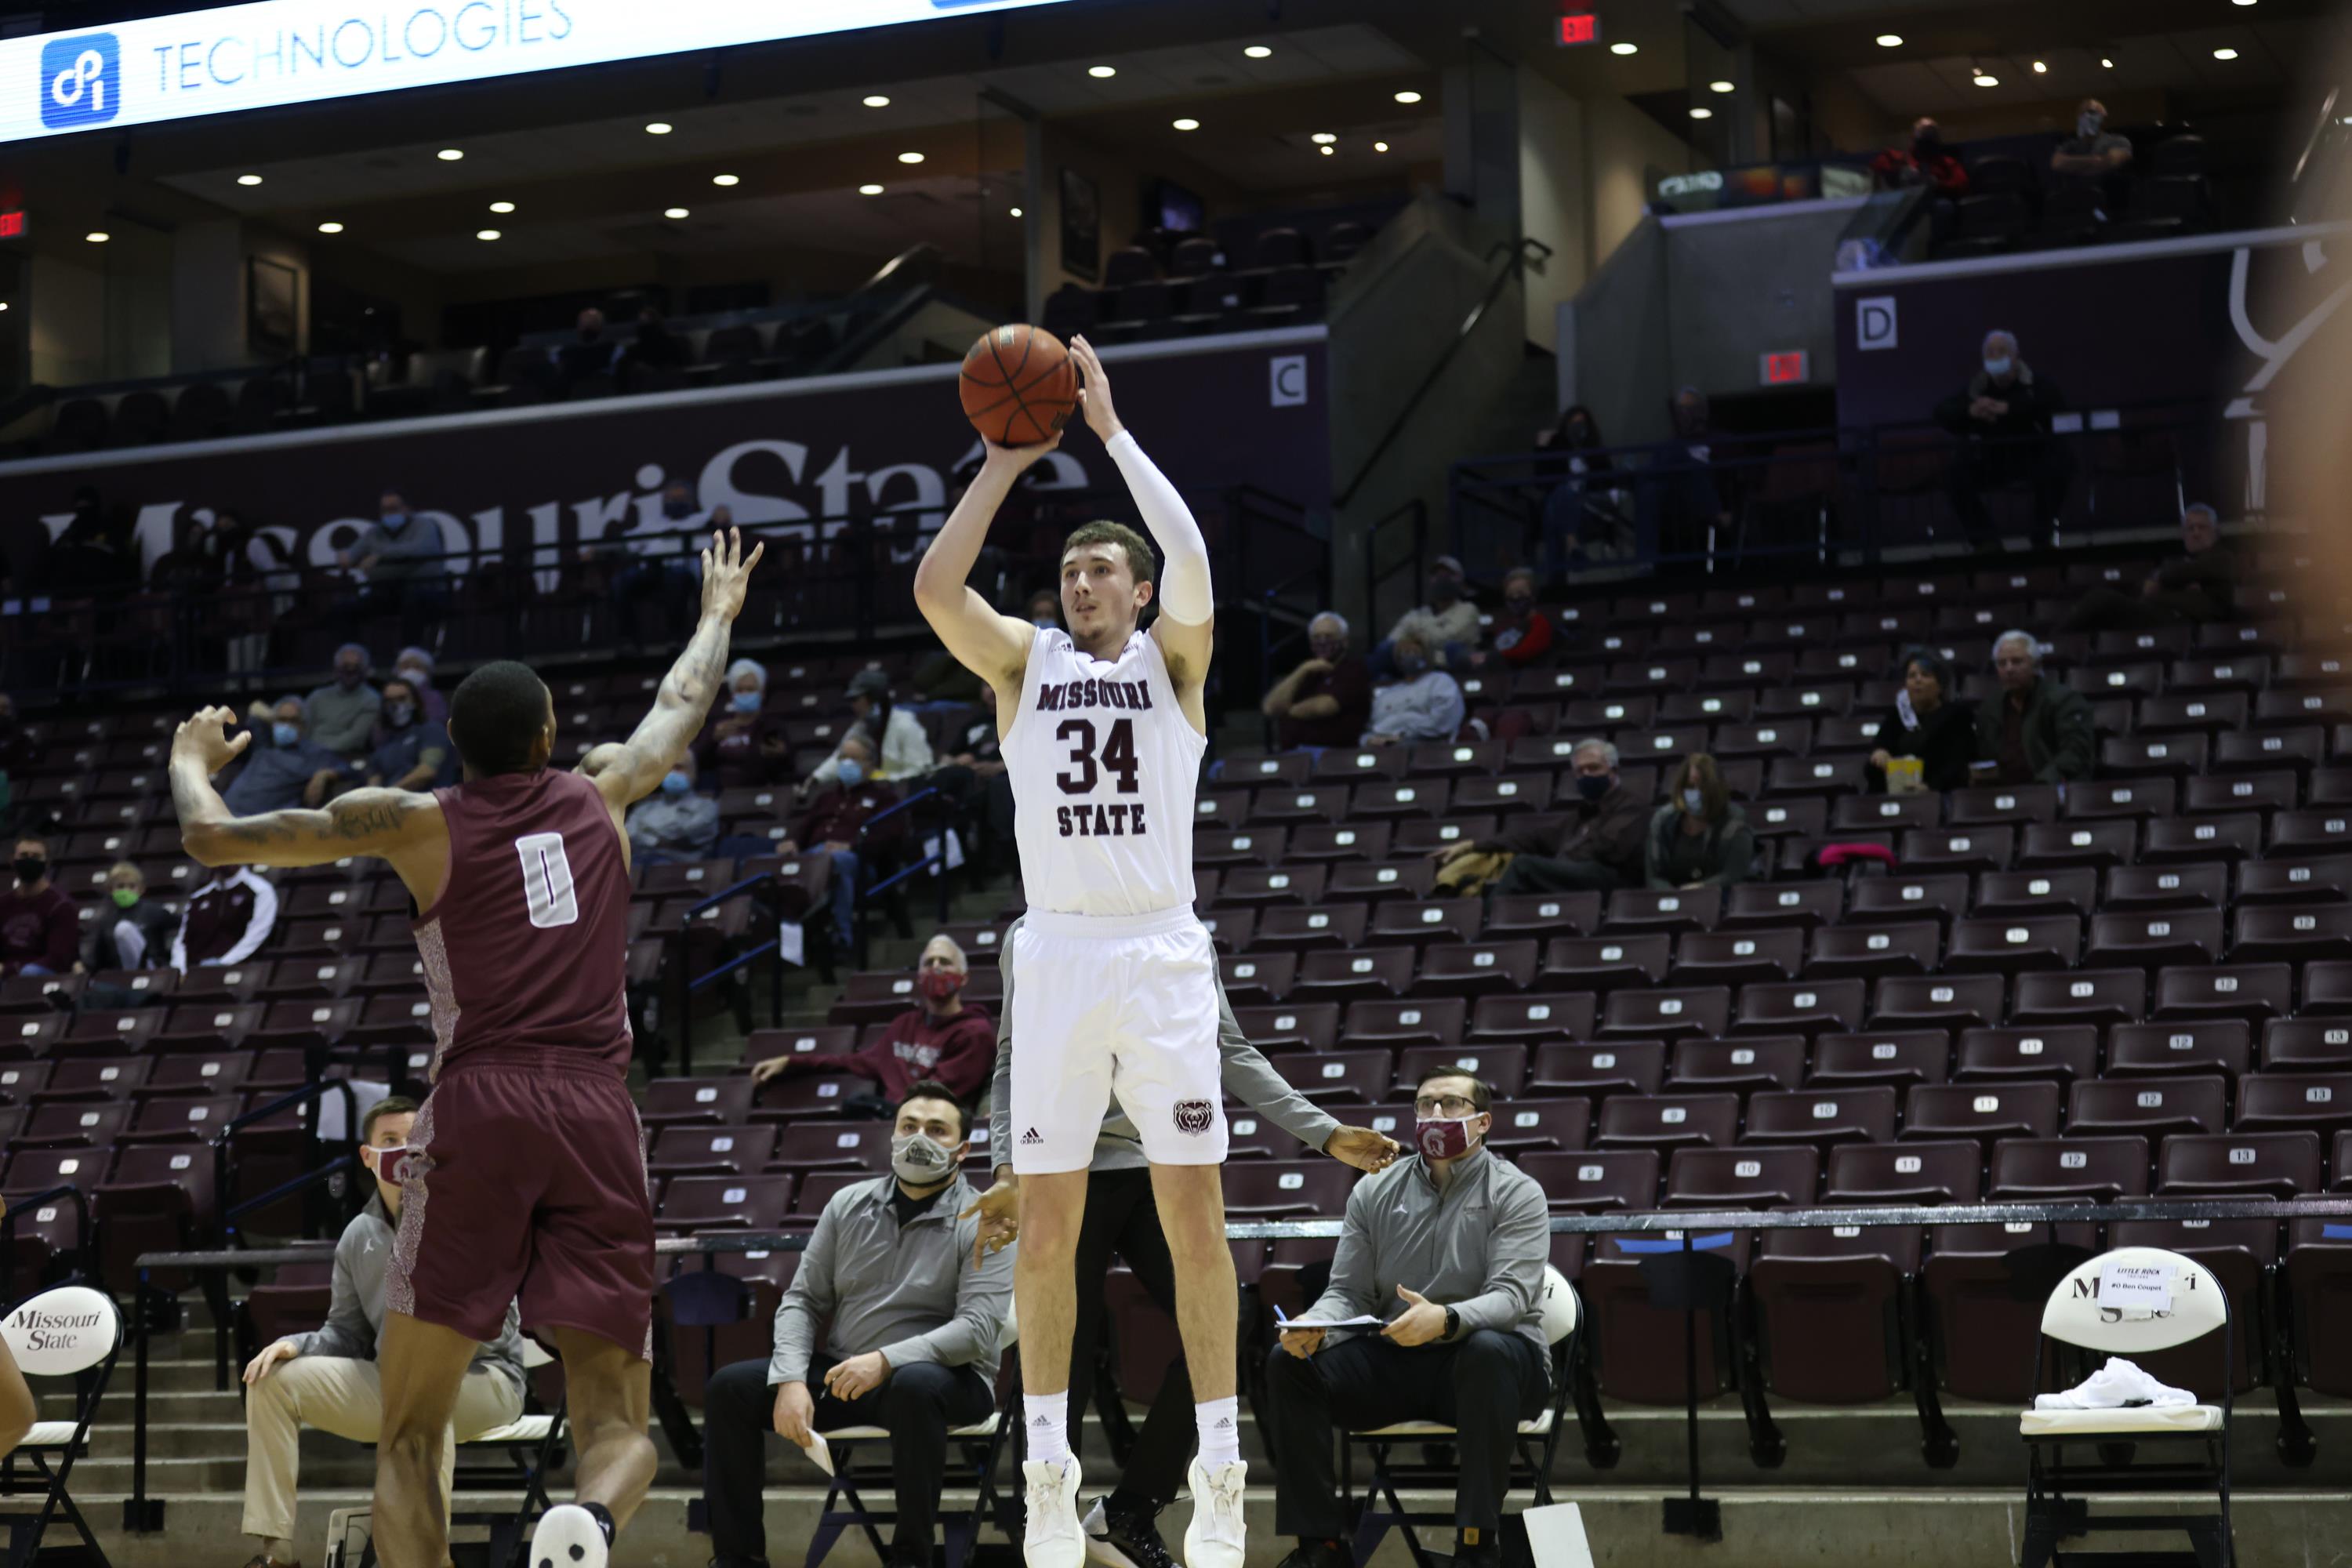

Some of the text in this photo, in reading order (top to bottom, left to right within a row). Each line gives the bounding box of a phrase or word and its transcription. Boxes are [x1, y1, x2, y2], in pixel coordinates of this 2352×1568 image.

[153, 0, 572, 92] TECHNOLOGIES
[1863, 307, 1892, 341] D
[1277, 363, 1300, 397] C
[1036, 678, 1152, 711] MISSOURI
[1055, 718, 1139, 795] 34
[1056, 804, 1146, 837] STATE
[515, 832, 579, 928] 0
[2141, 1267, 2160, 1276] ROCK
[11, 1309, 101, 1330] Missouri
[27, 1330, 78, 1351] State
